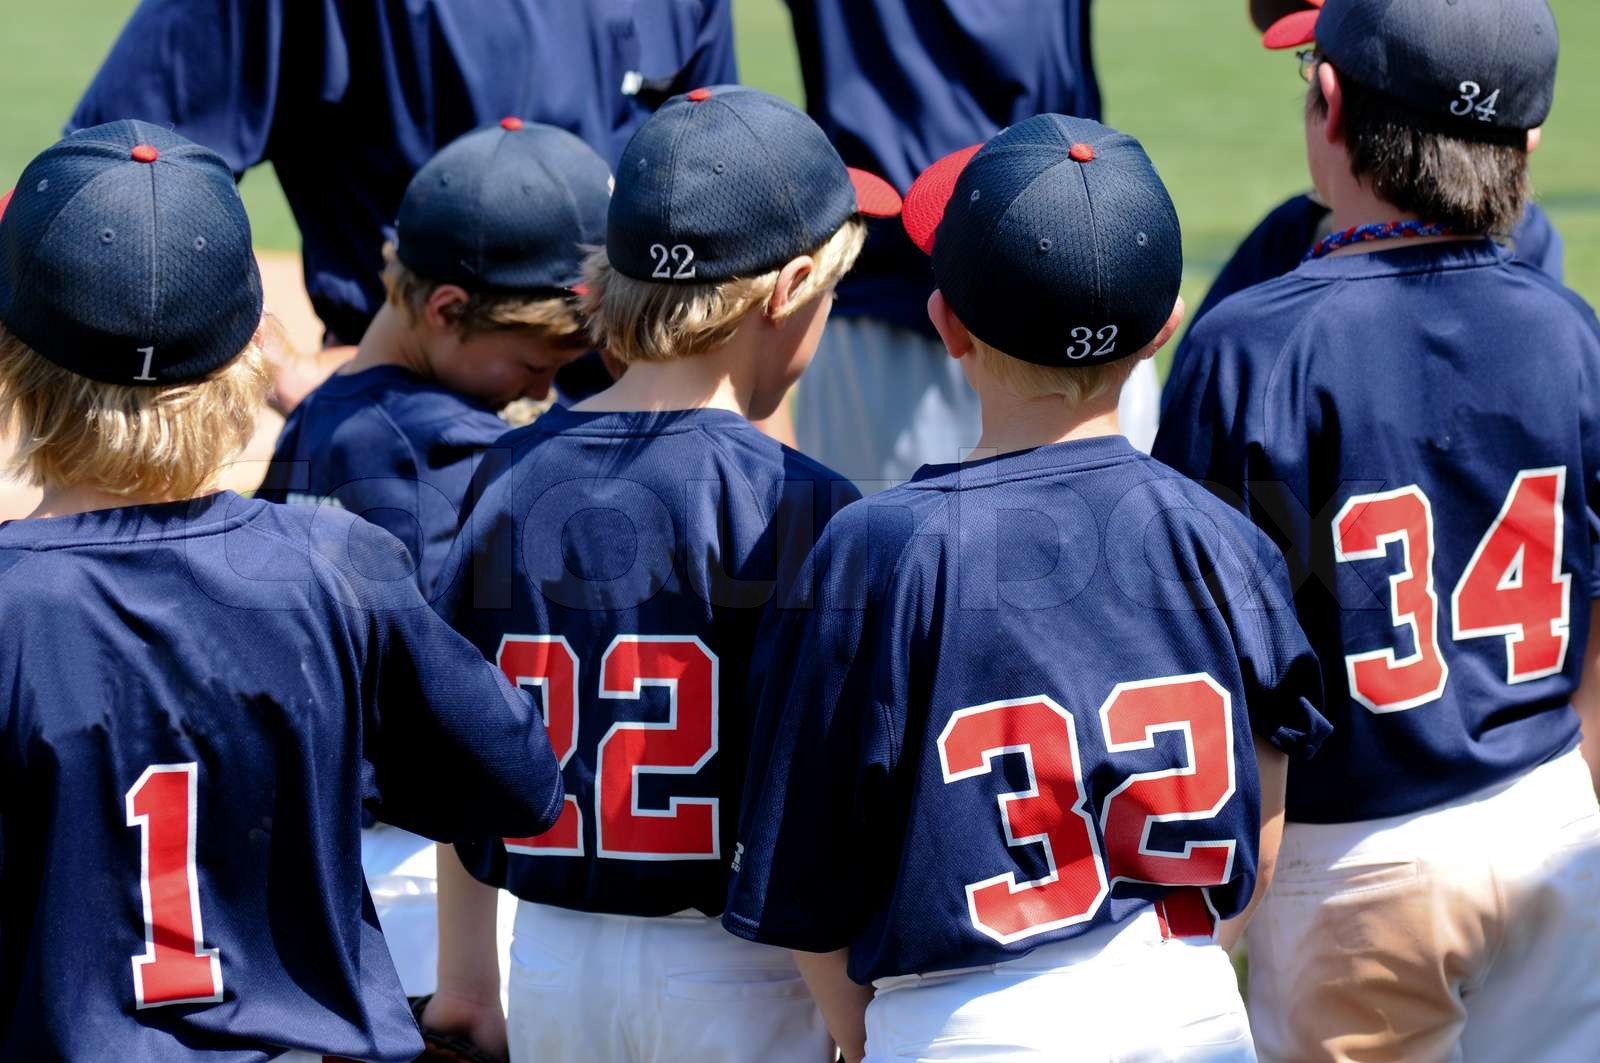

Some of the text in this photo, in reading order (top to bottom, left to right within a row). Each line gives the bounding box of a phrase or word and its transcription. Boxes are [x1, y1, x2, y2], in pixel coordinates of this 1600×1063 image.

[1449, 80, 1500, 122] 34
[649, 243, 696, 279] 22
[132, 345, 157, 381] 1
[1066, 324, 1118, 360] 32
[1331, 465, 1572, 714] 34
[937, 672, 1237, 944] 32
[125, 762, 223, 1010] 1
